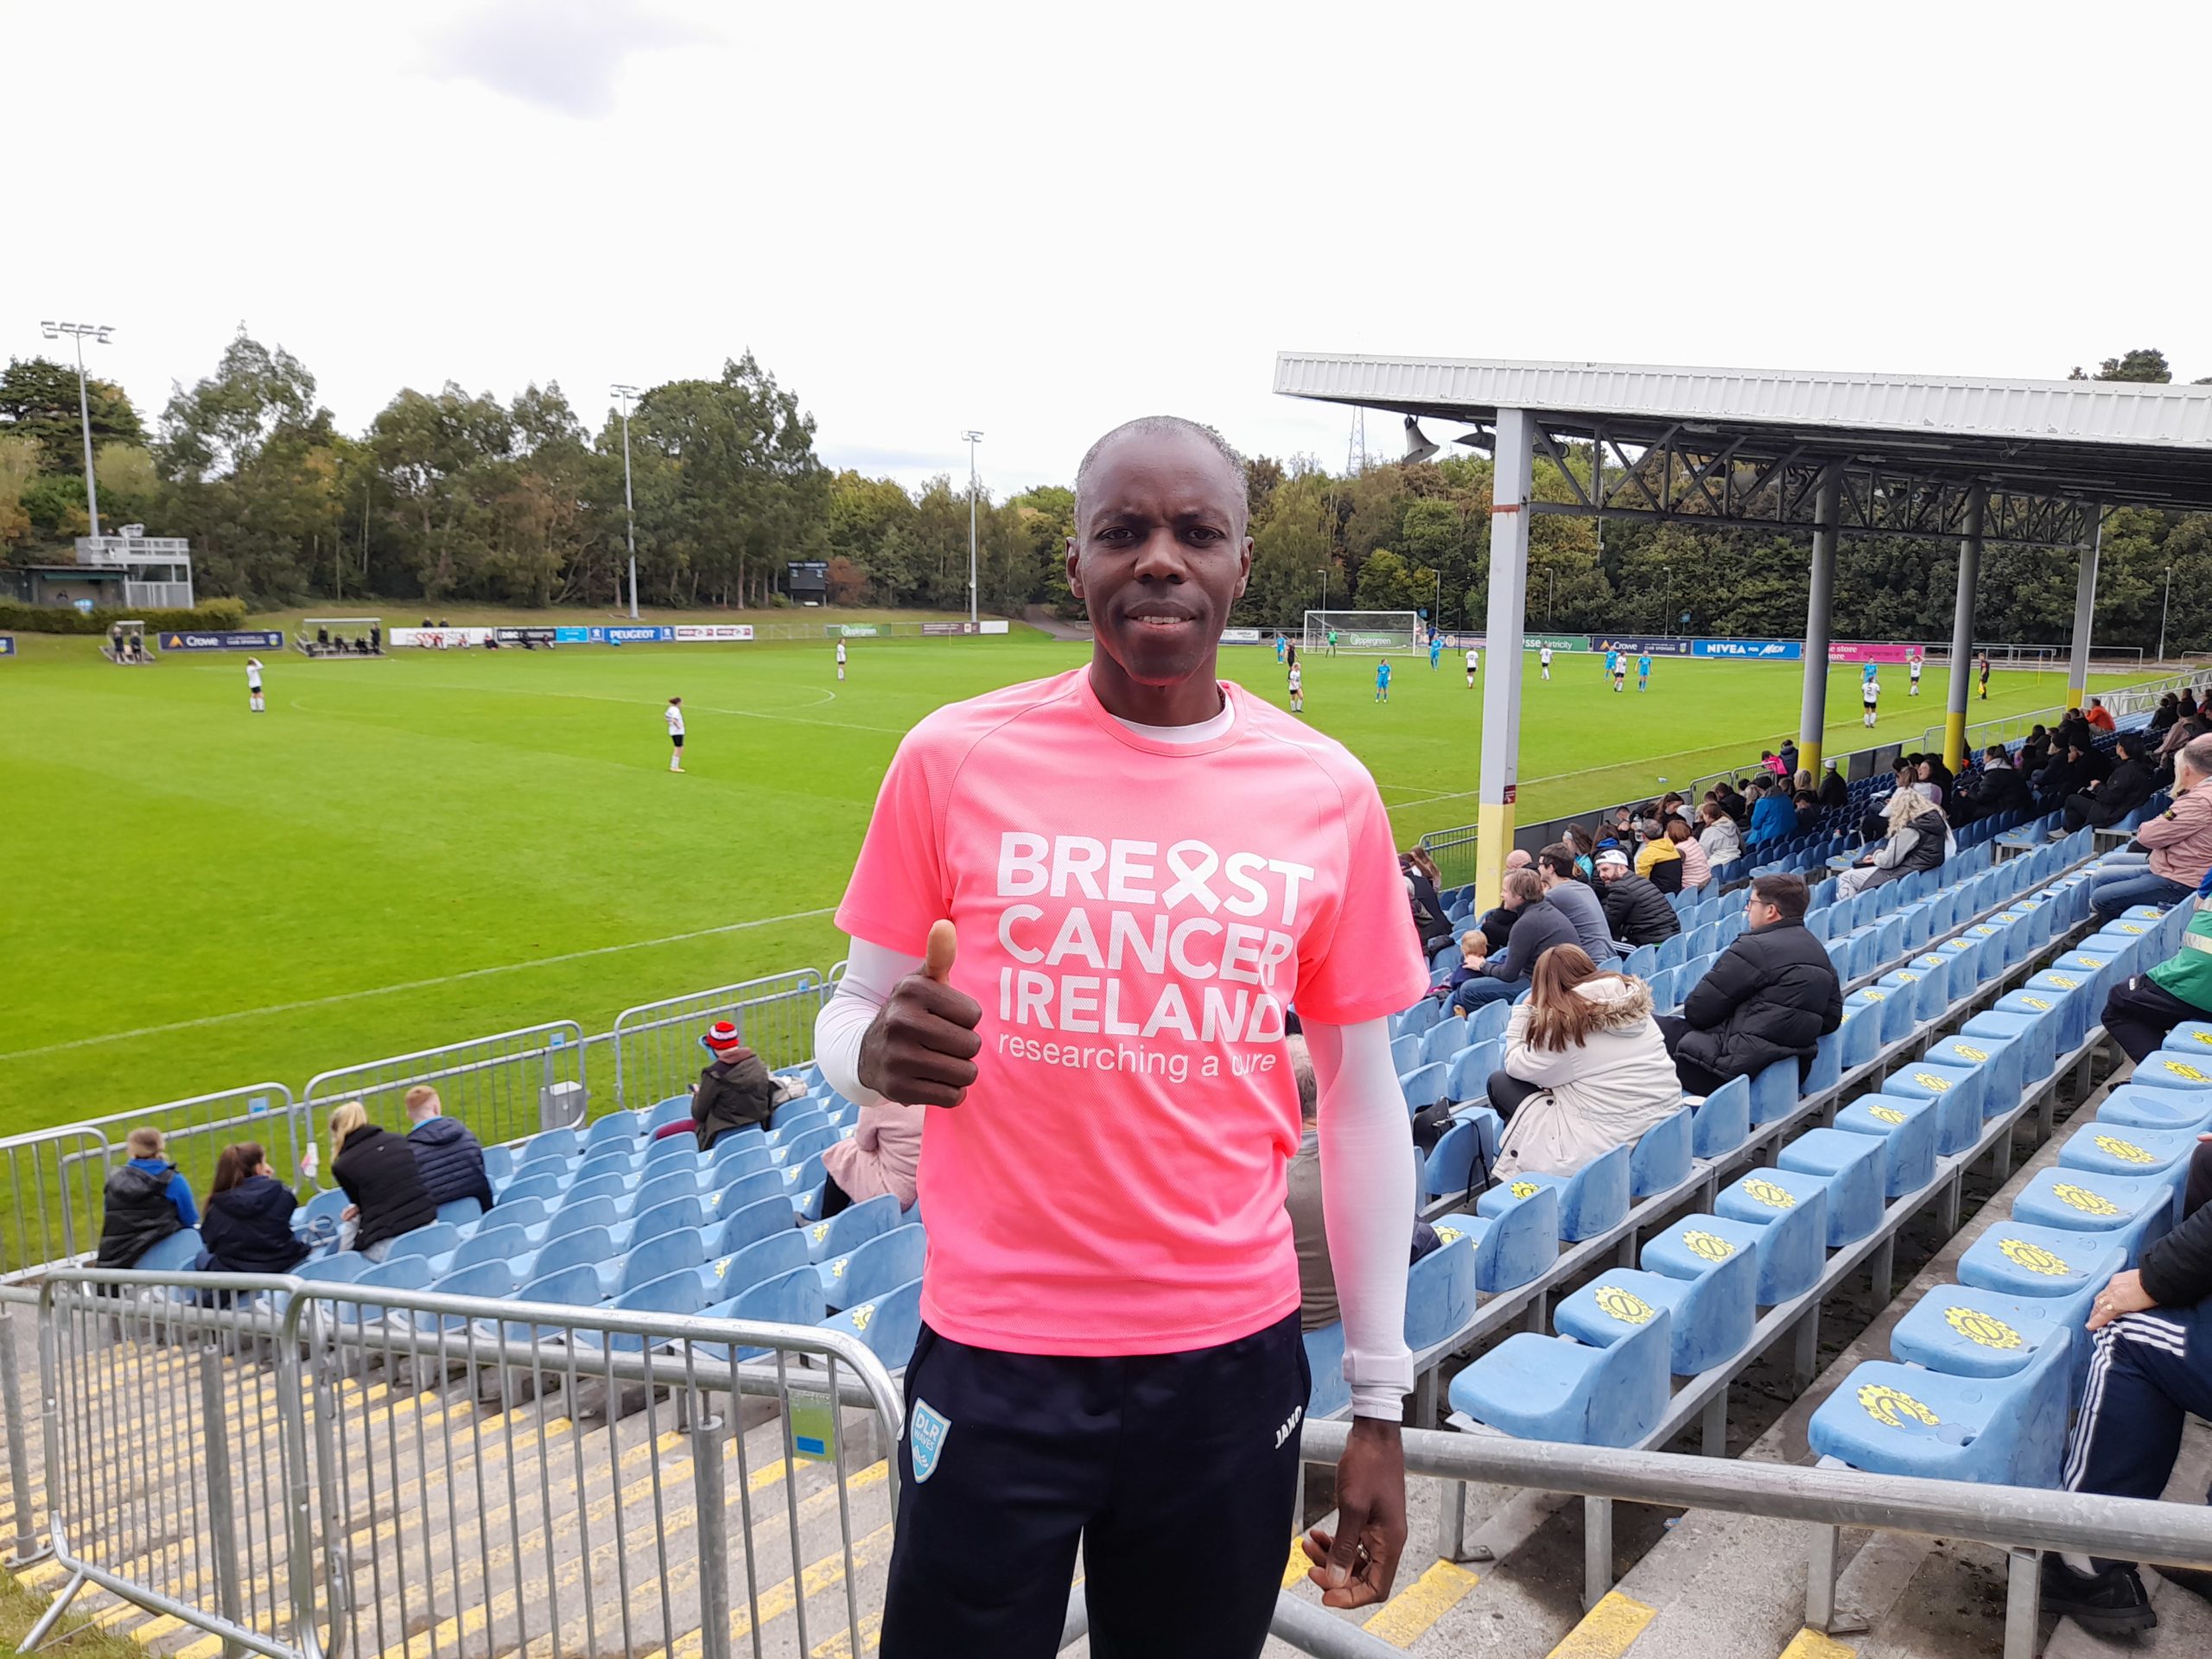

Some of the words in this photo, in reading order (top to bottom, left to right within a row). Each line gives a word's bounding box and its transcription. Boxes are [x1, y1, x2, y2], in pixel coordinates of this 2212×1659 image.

[186, 635, 219, 646] Crowe
[610, 630, 656, 639] PEUGEOT
[1613, 641, 1637, 651] Crowe
[1707, 644, 1746, 654] NIVEA
[998, 904, 1294, 987] CANCER
[1000, 967, 1285, 1044] IRELAND
[998, 1033, 1189, 1084] researching
[1201, 1055, 1219, 1077] a
[1231, 1052, 1277, 1077] cure
[914, 1427, 935, 1452] WAVES
[916, 1412, 940, 1441] DLR
[1274, 1405, 1302, 1450] JAKO
